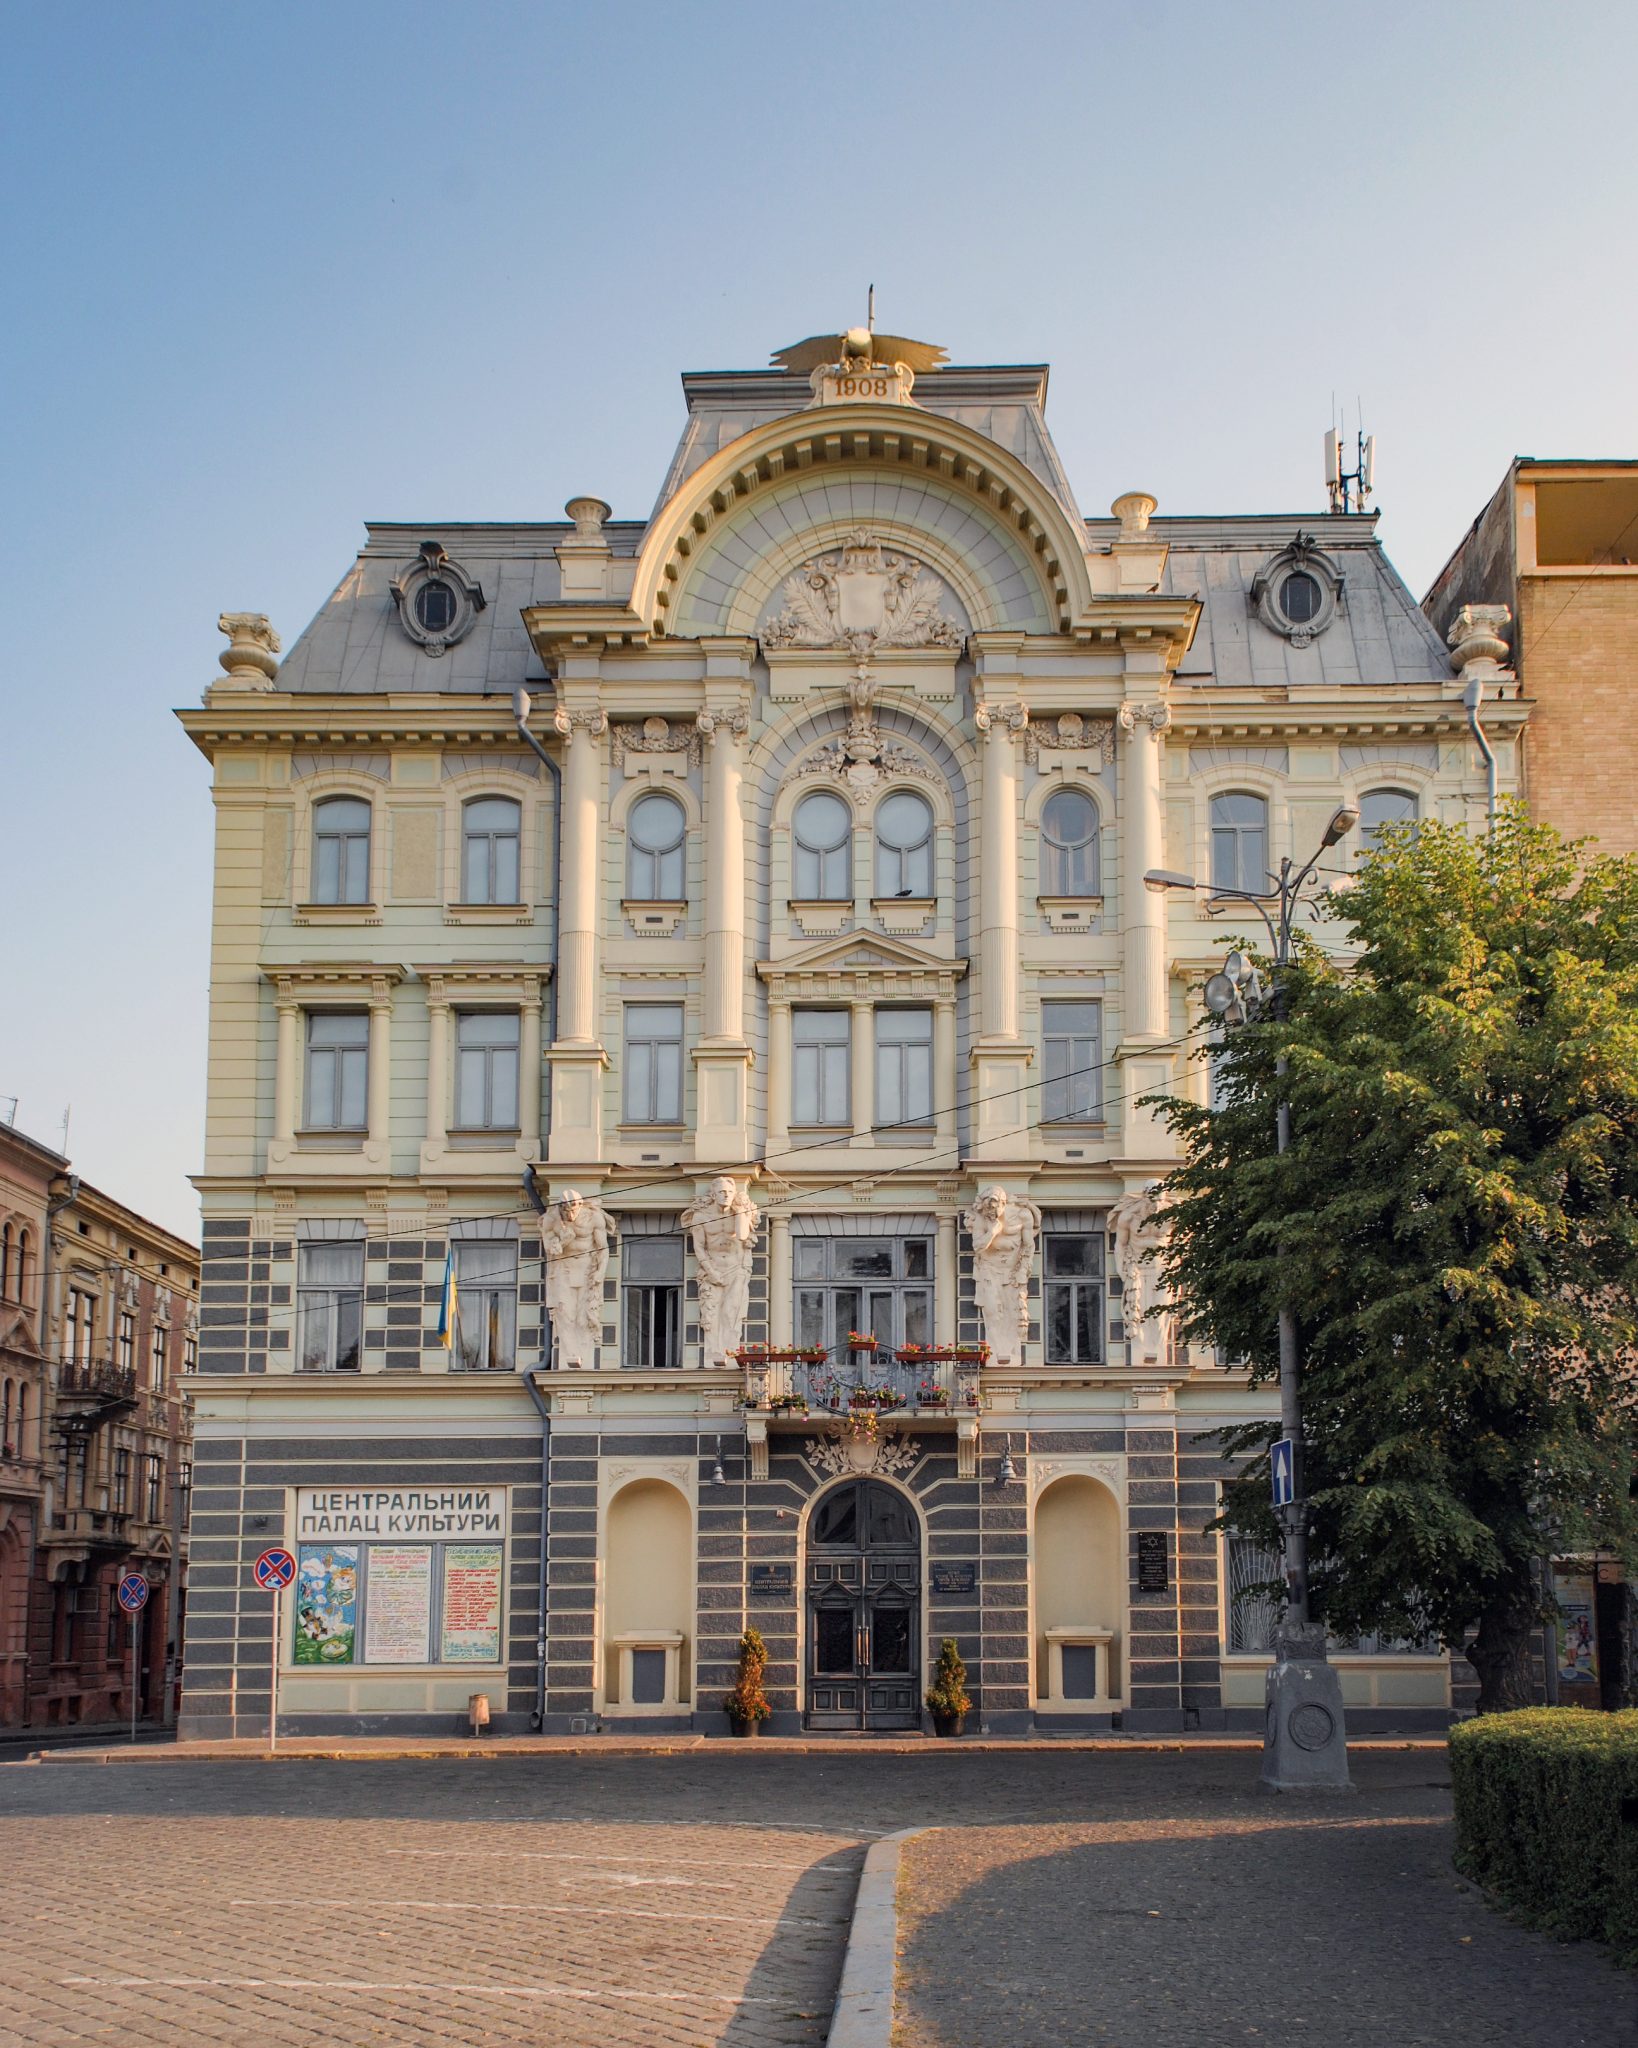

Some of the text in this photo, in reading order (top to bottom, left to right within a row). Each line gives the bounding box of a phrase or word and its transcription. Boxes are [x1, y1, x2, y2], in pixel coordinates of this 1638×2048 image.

[835, 378, 888, 397] 1908
[312, 1490, 490, 1512] ЦЕНТРАЛЬНИЙ
[302, 1514, 500, 1533] ПАЛАЦ КУЛЬТУРИ
